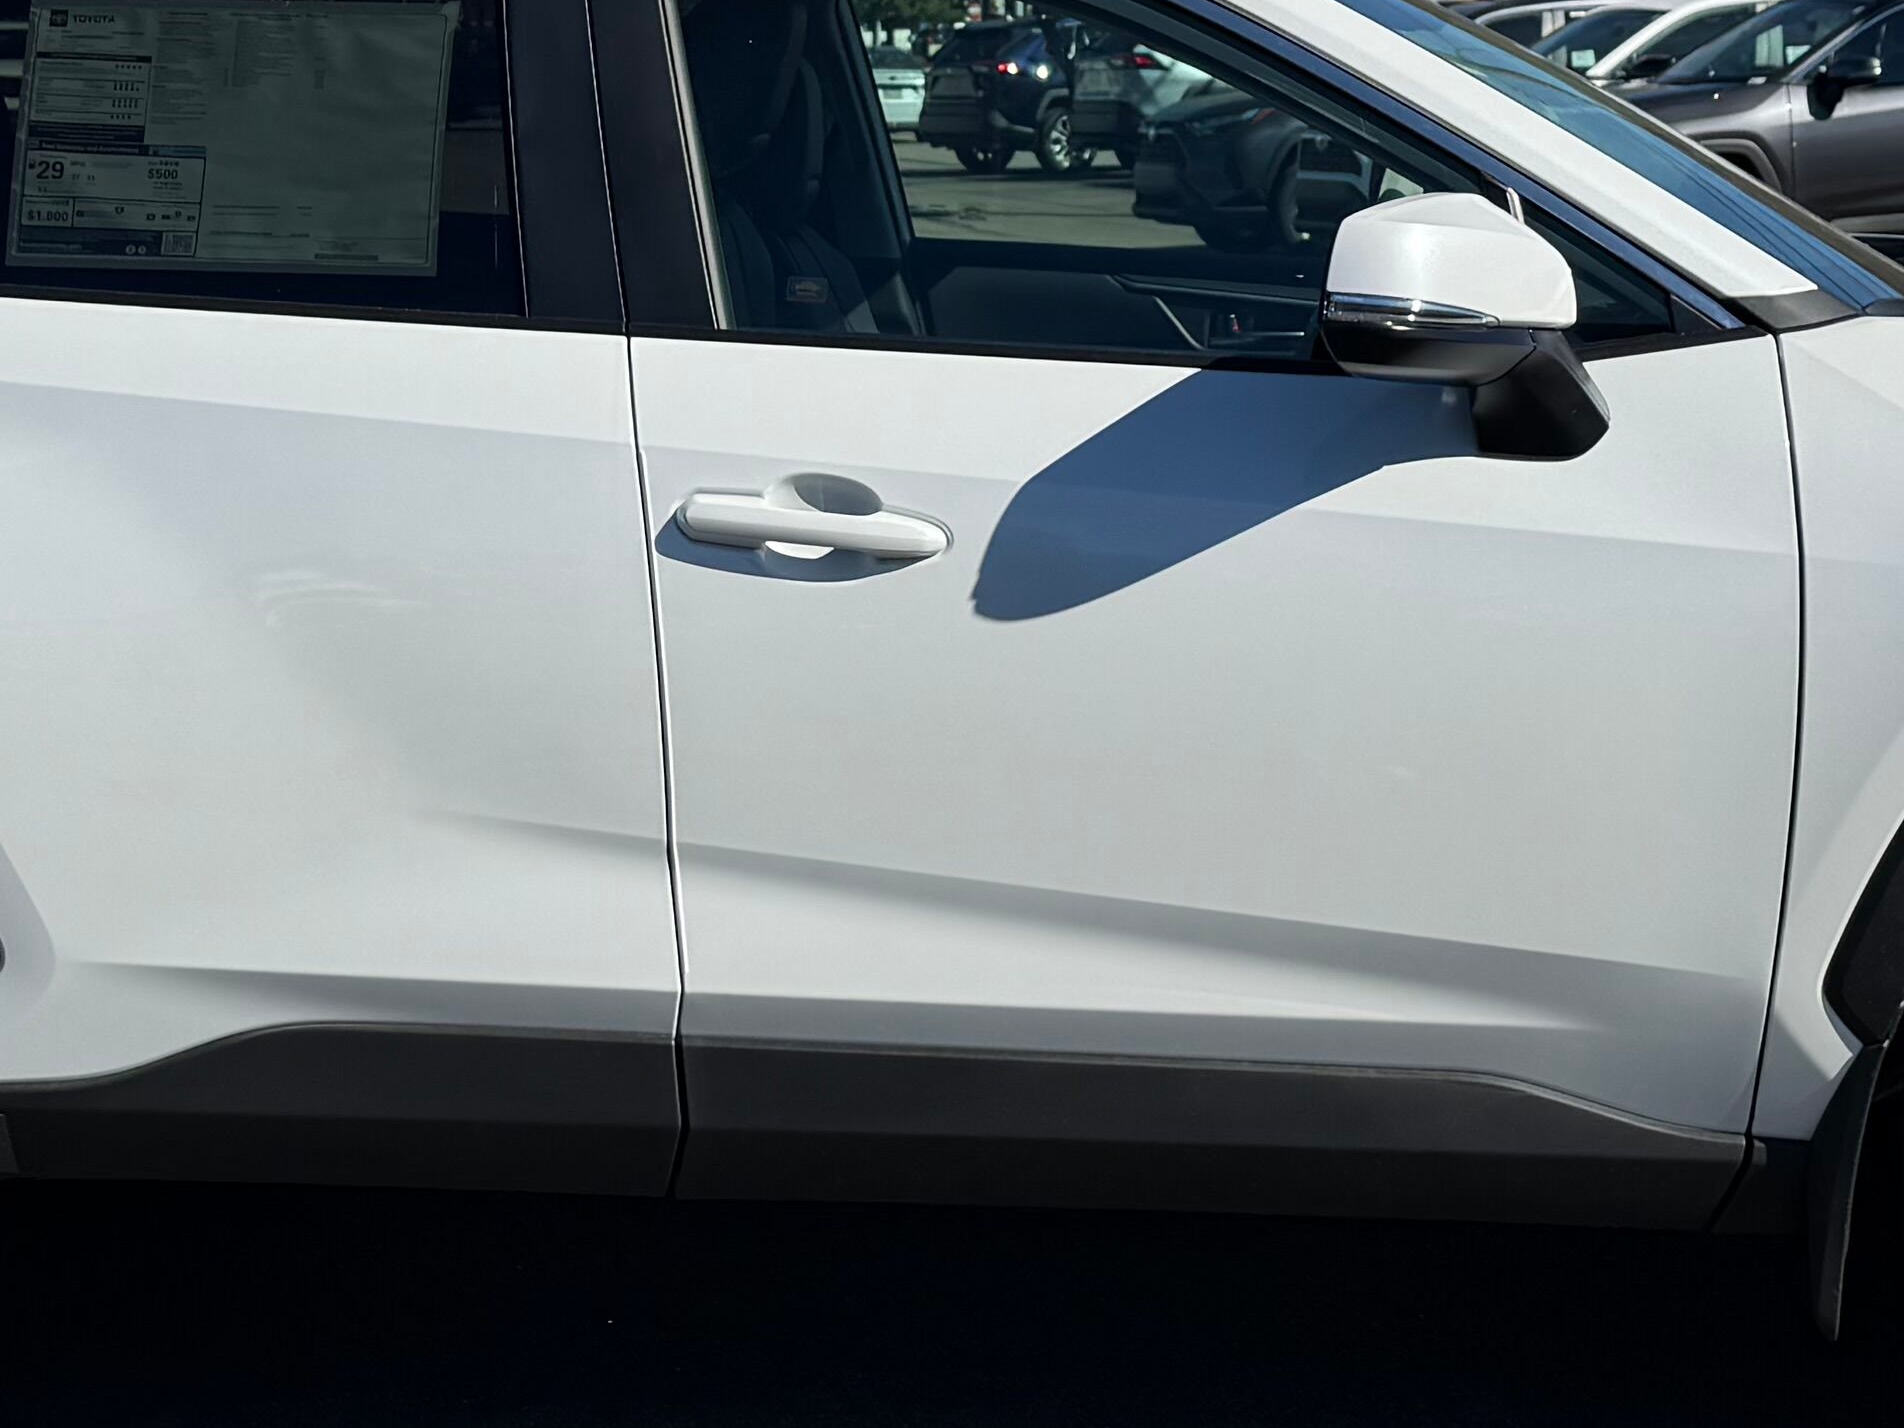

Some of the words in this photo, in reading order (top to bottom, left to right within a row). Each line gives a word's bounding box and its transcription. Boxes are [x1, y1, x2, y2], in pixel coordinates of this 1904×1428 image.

[73, 14, 115, 23] TOYOTA
[36, 160, 65, 179] 29
[147, 168, 179, 179] $500
